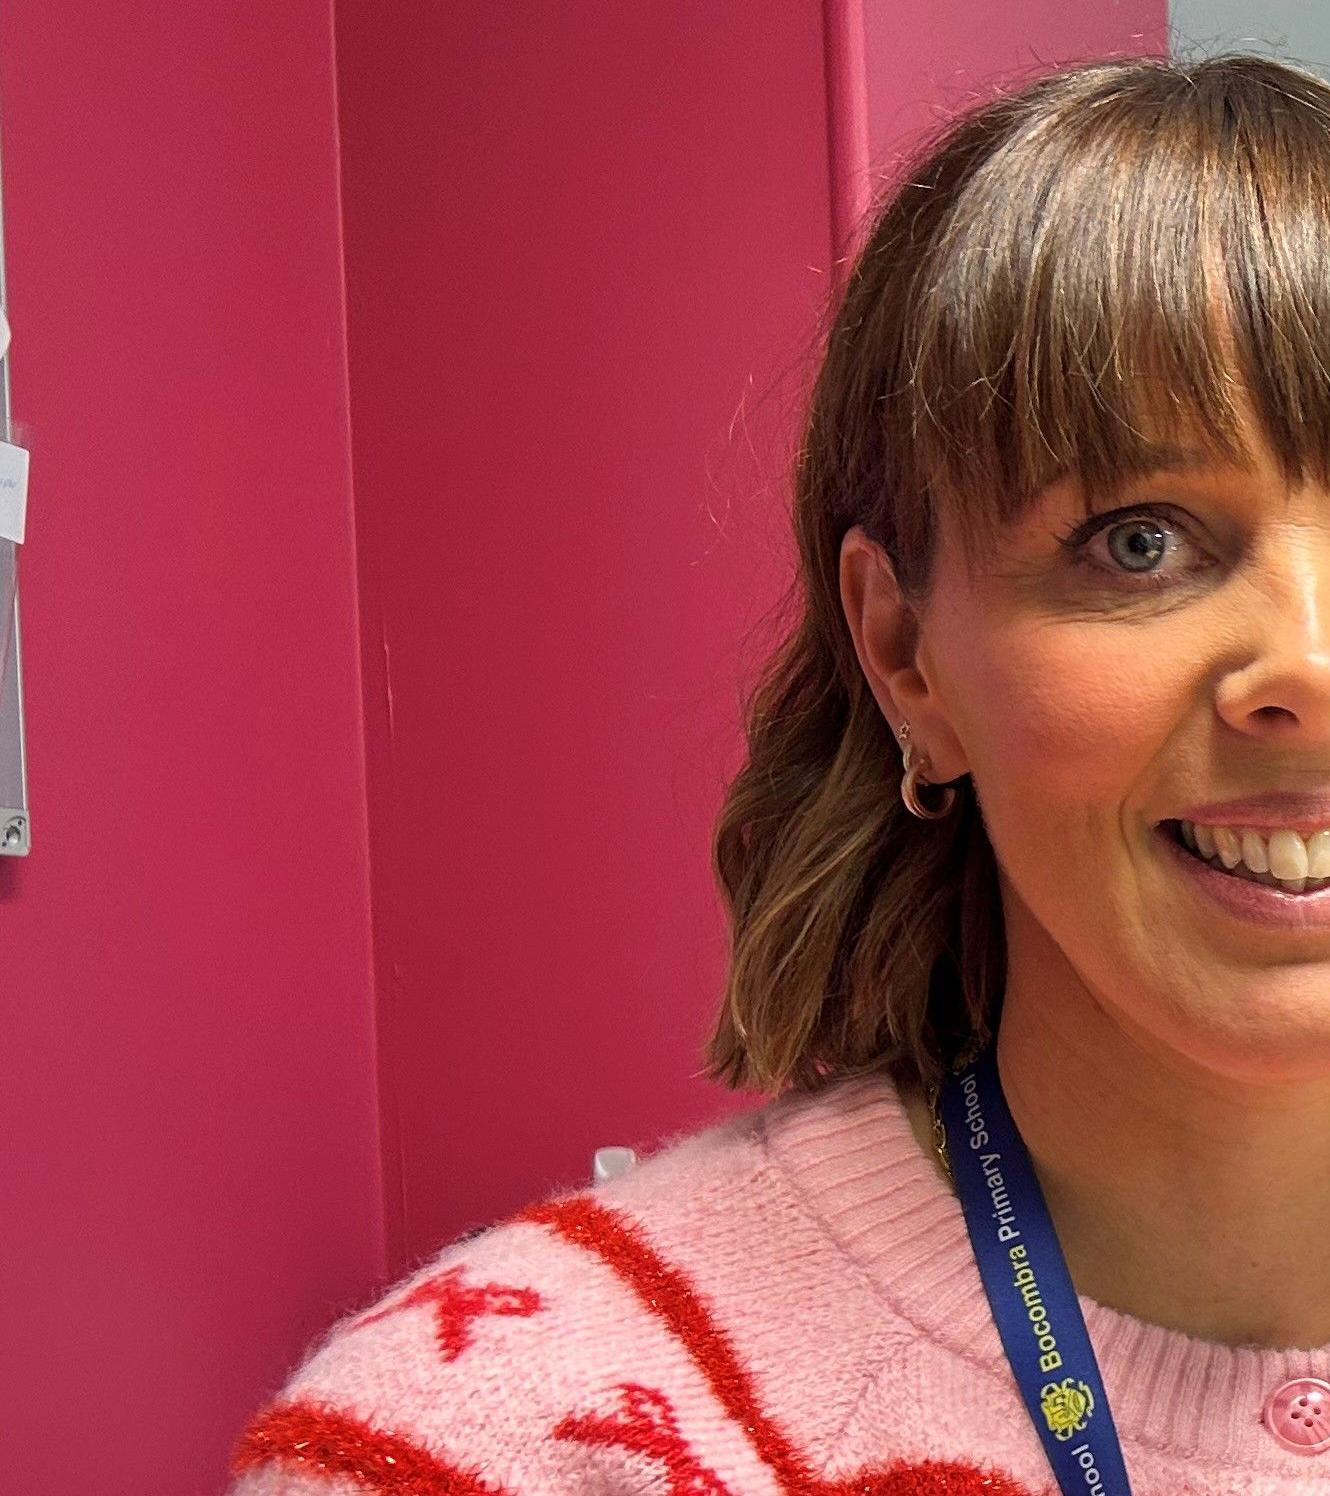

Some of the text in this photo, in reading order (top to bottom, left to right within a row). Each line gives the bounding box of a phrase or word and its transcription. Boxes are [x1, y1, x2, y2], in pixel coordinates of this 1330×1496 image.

[960, 1073, 1063, 1372] Bocombra Primary School
